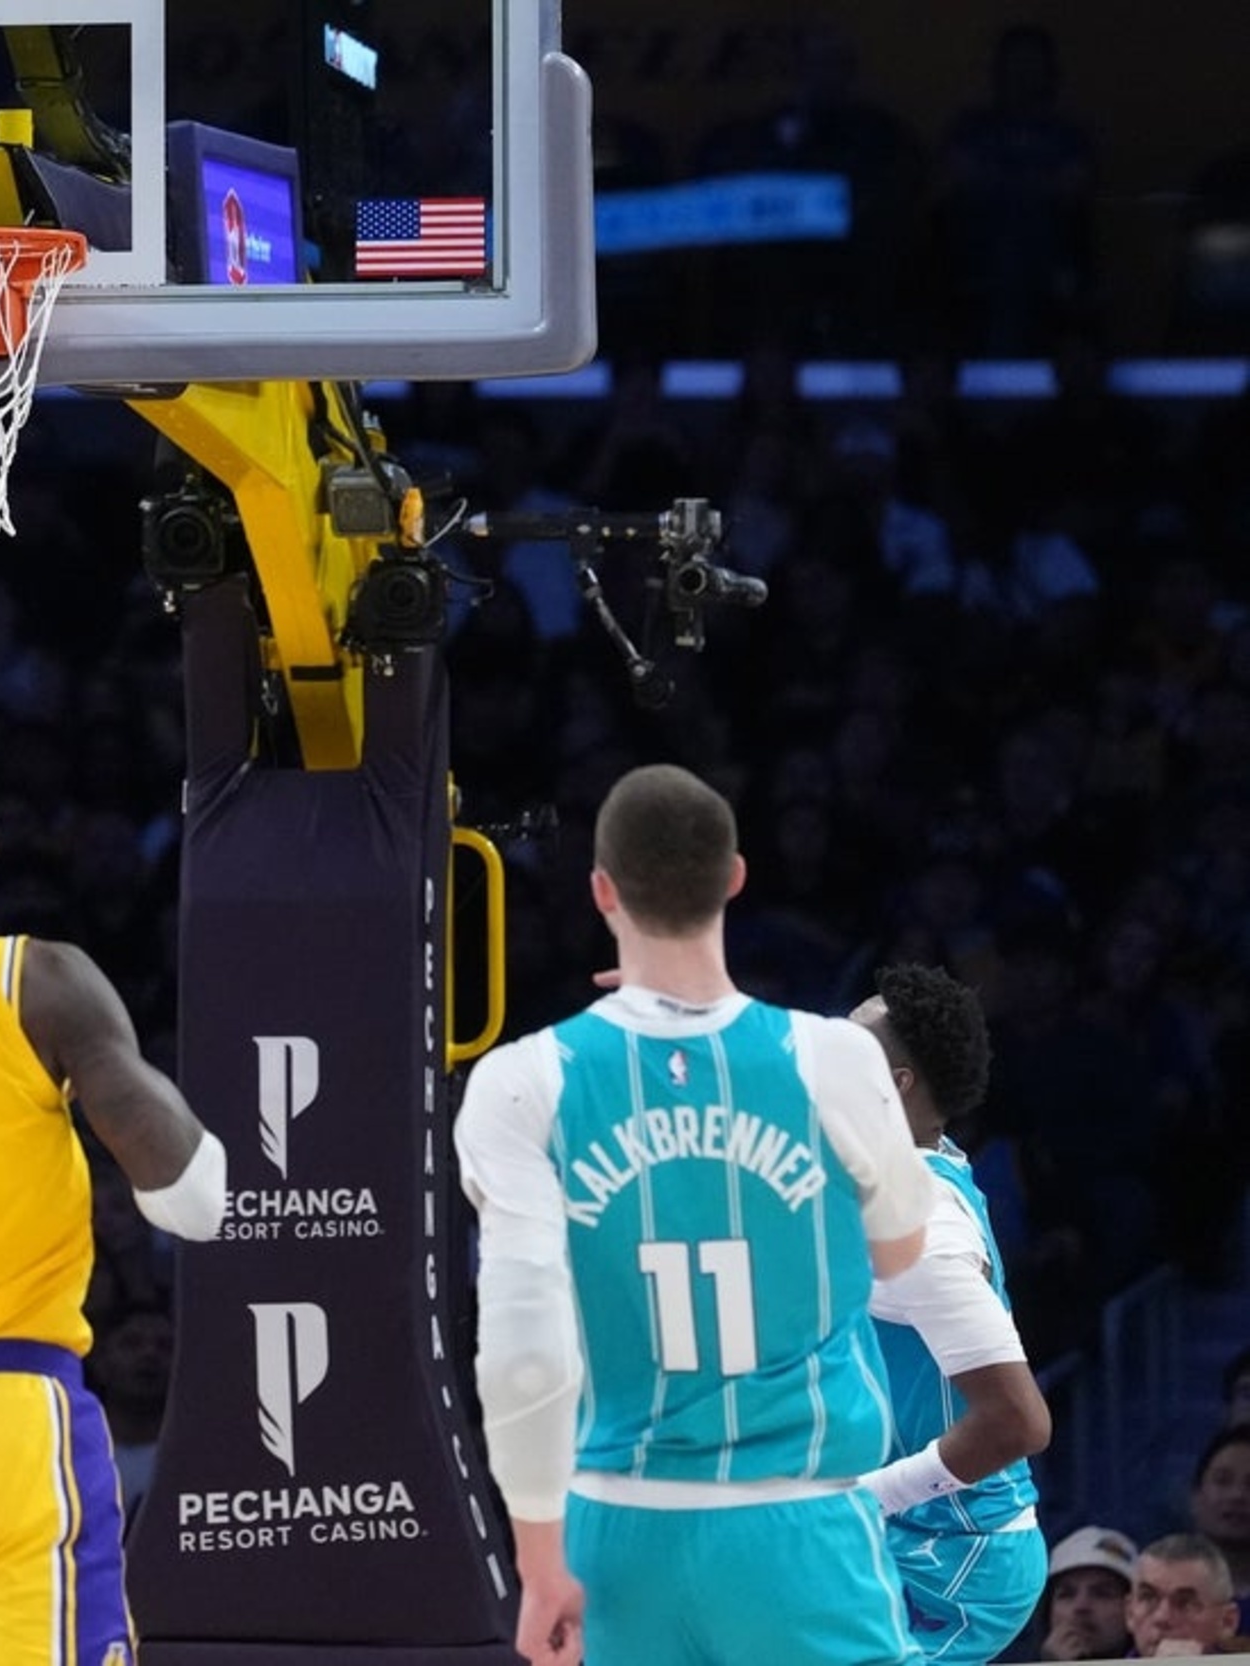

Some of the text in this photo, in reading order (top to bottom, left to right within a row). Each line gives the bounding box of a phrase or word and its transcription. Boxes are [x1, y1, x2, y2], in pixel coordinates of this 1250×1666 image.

[565, 1104, 827, 1229] KALKBRENNER
[224, 1187, 378, 1218] ECHANGA
[215, 1221, 282, 1241] SORT
[637, 1238, 760, 1377] 11
[178, 1481, 415, 1526] PECHANGA
[179, 1526, 292, 1553] RESORT
